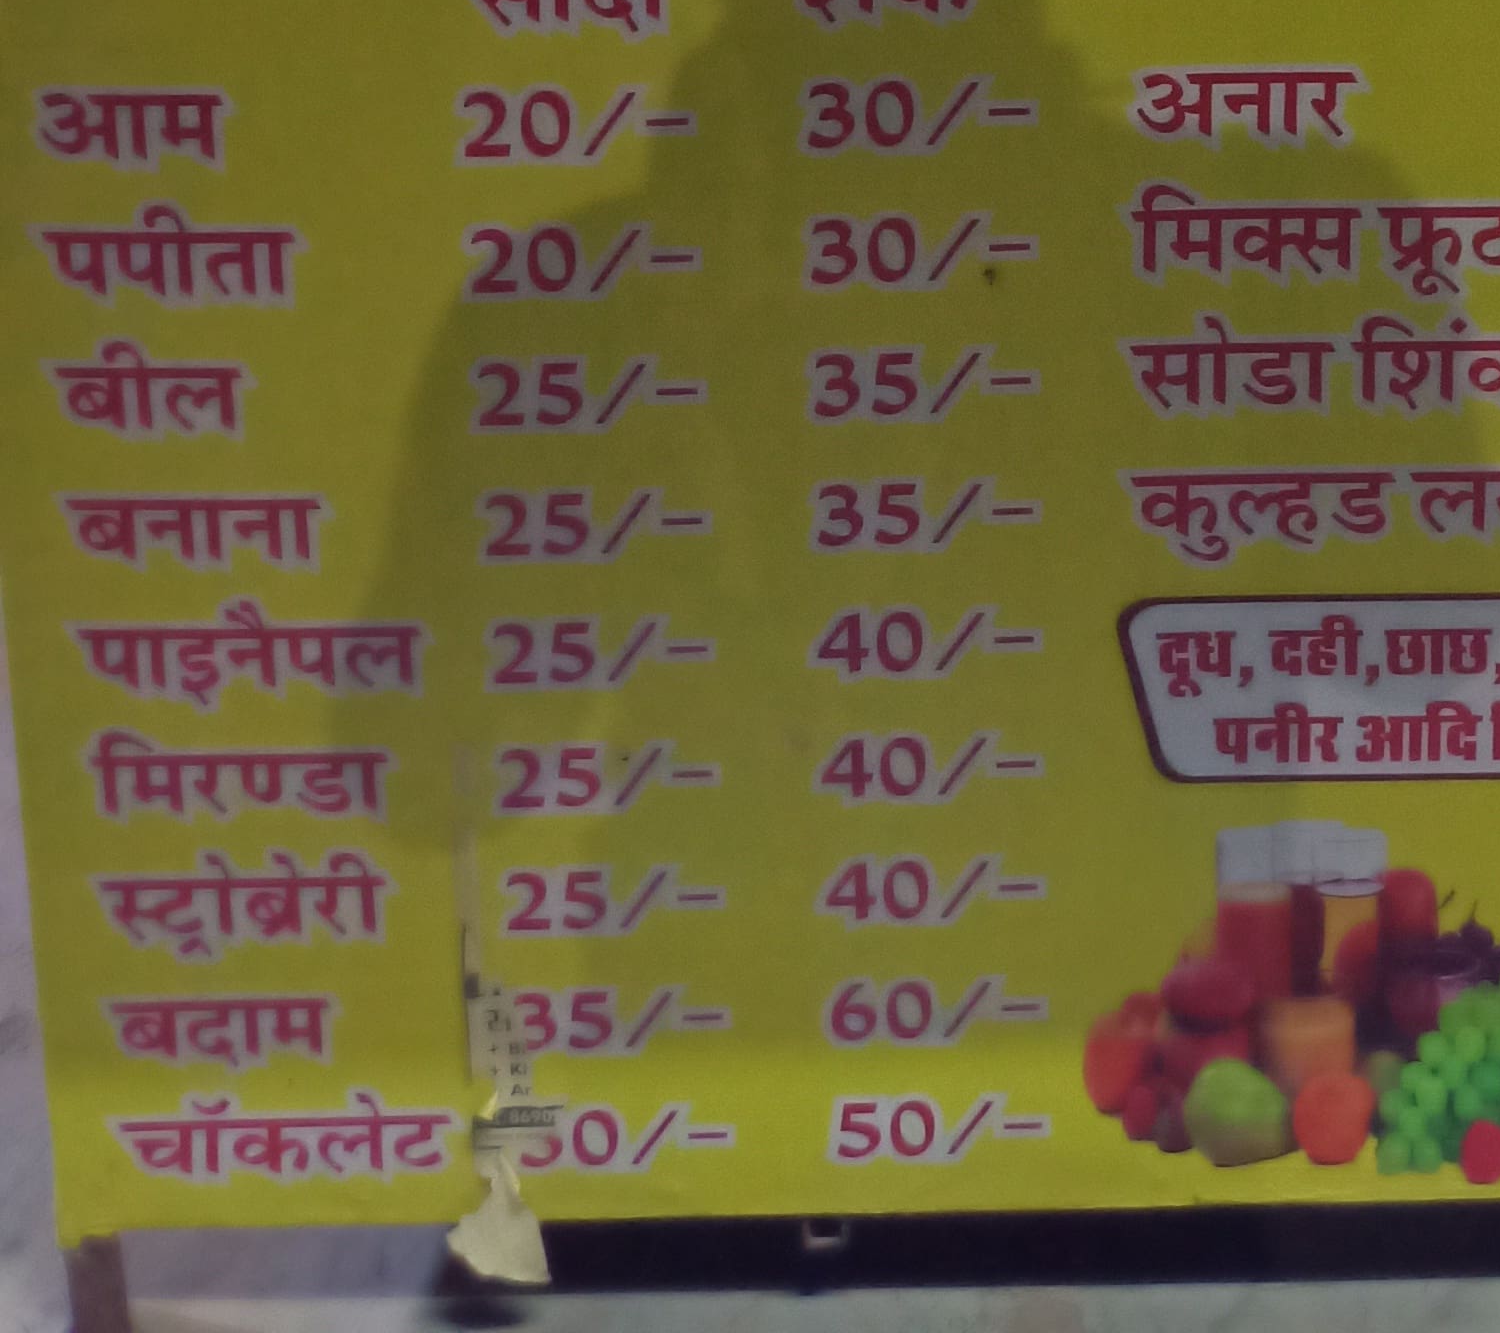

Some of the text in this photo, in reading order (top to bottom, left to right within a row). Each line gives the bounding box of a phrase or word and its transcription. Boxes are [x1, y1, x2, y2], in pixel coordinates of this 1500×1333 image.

[43, 79, 1029, 159] आम 20/- 30/-
[1139, 71, 1356, 135] अनार
[43, 205, 1030, 295] पपीता 20/- 30/-
[1131, 185, 1361, 272] मिक्स
[55, 341, 1031, 429] बील 25/- 35/-
[1131, 317, 1334, 406] सोडा
[67, 483, 1032, 560] बनाना 25/- 35/-
[491, 621, 710, 687] 25/-
[818, 611, 1035, 674] 40/-
[1215, 703, 1342, 763] पनीर
[1356, 702, 1481, 762] आदि
[91, 733, 1034, 814] मिरण्डा 25/- 40/-
[507, 871, 716, 933] 25/-
[825, 860, 1039, 921] 40/-
[112, 981, 1040, 1064] बदाम 35/- 60/-
[120, 1094, 450, 1175] चॉकलेट
[837, 1100, 1041, 1161] 50/-
